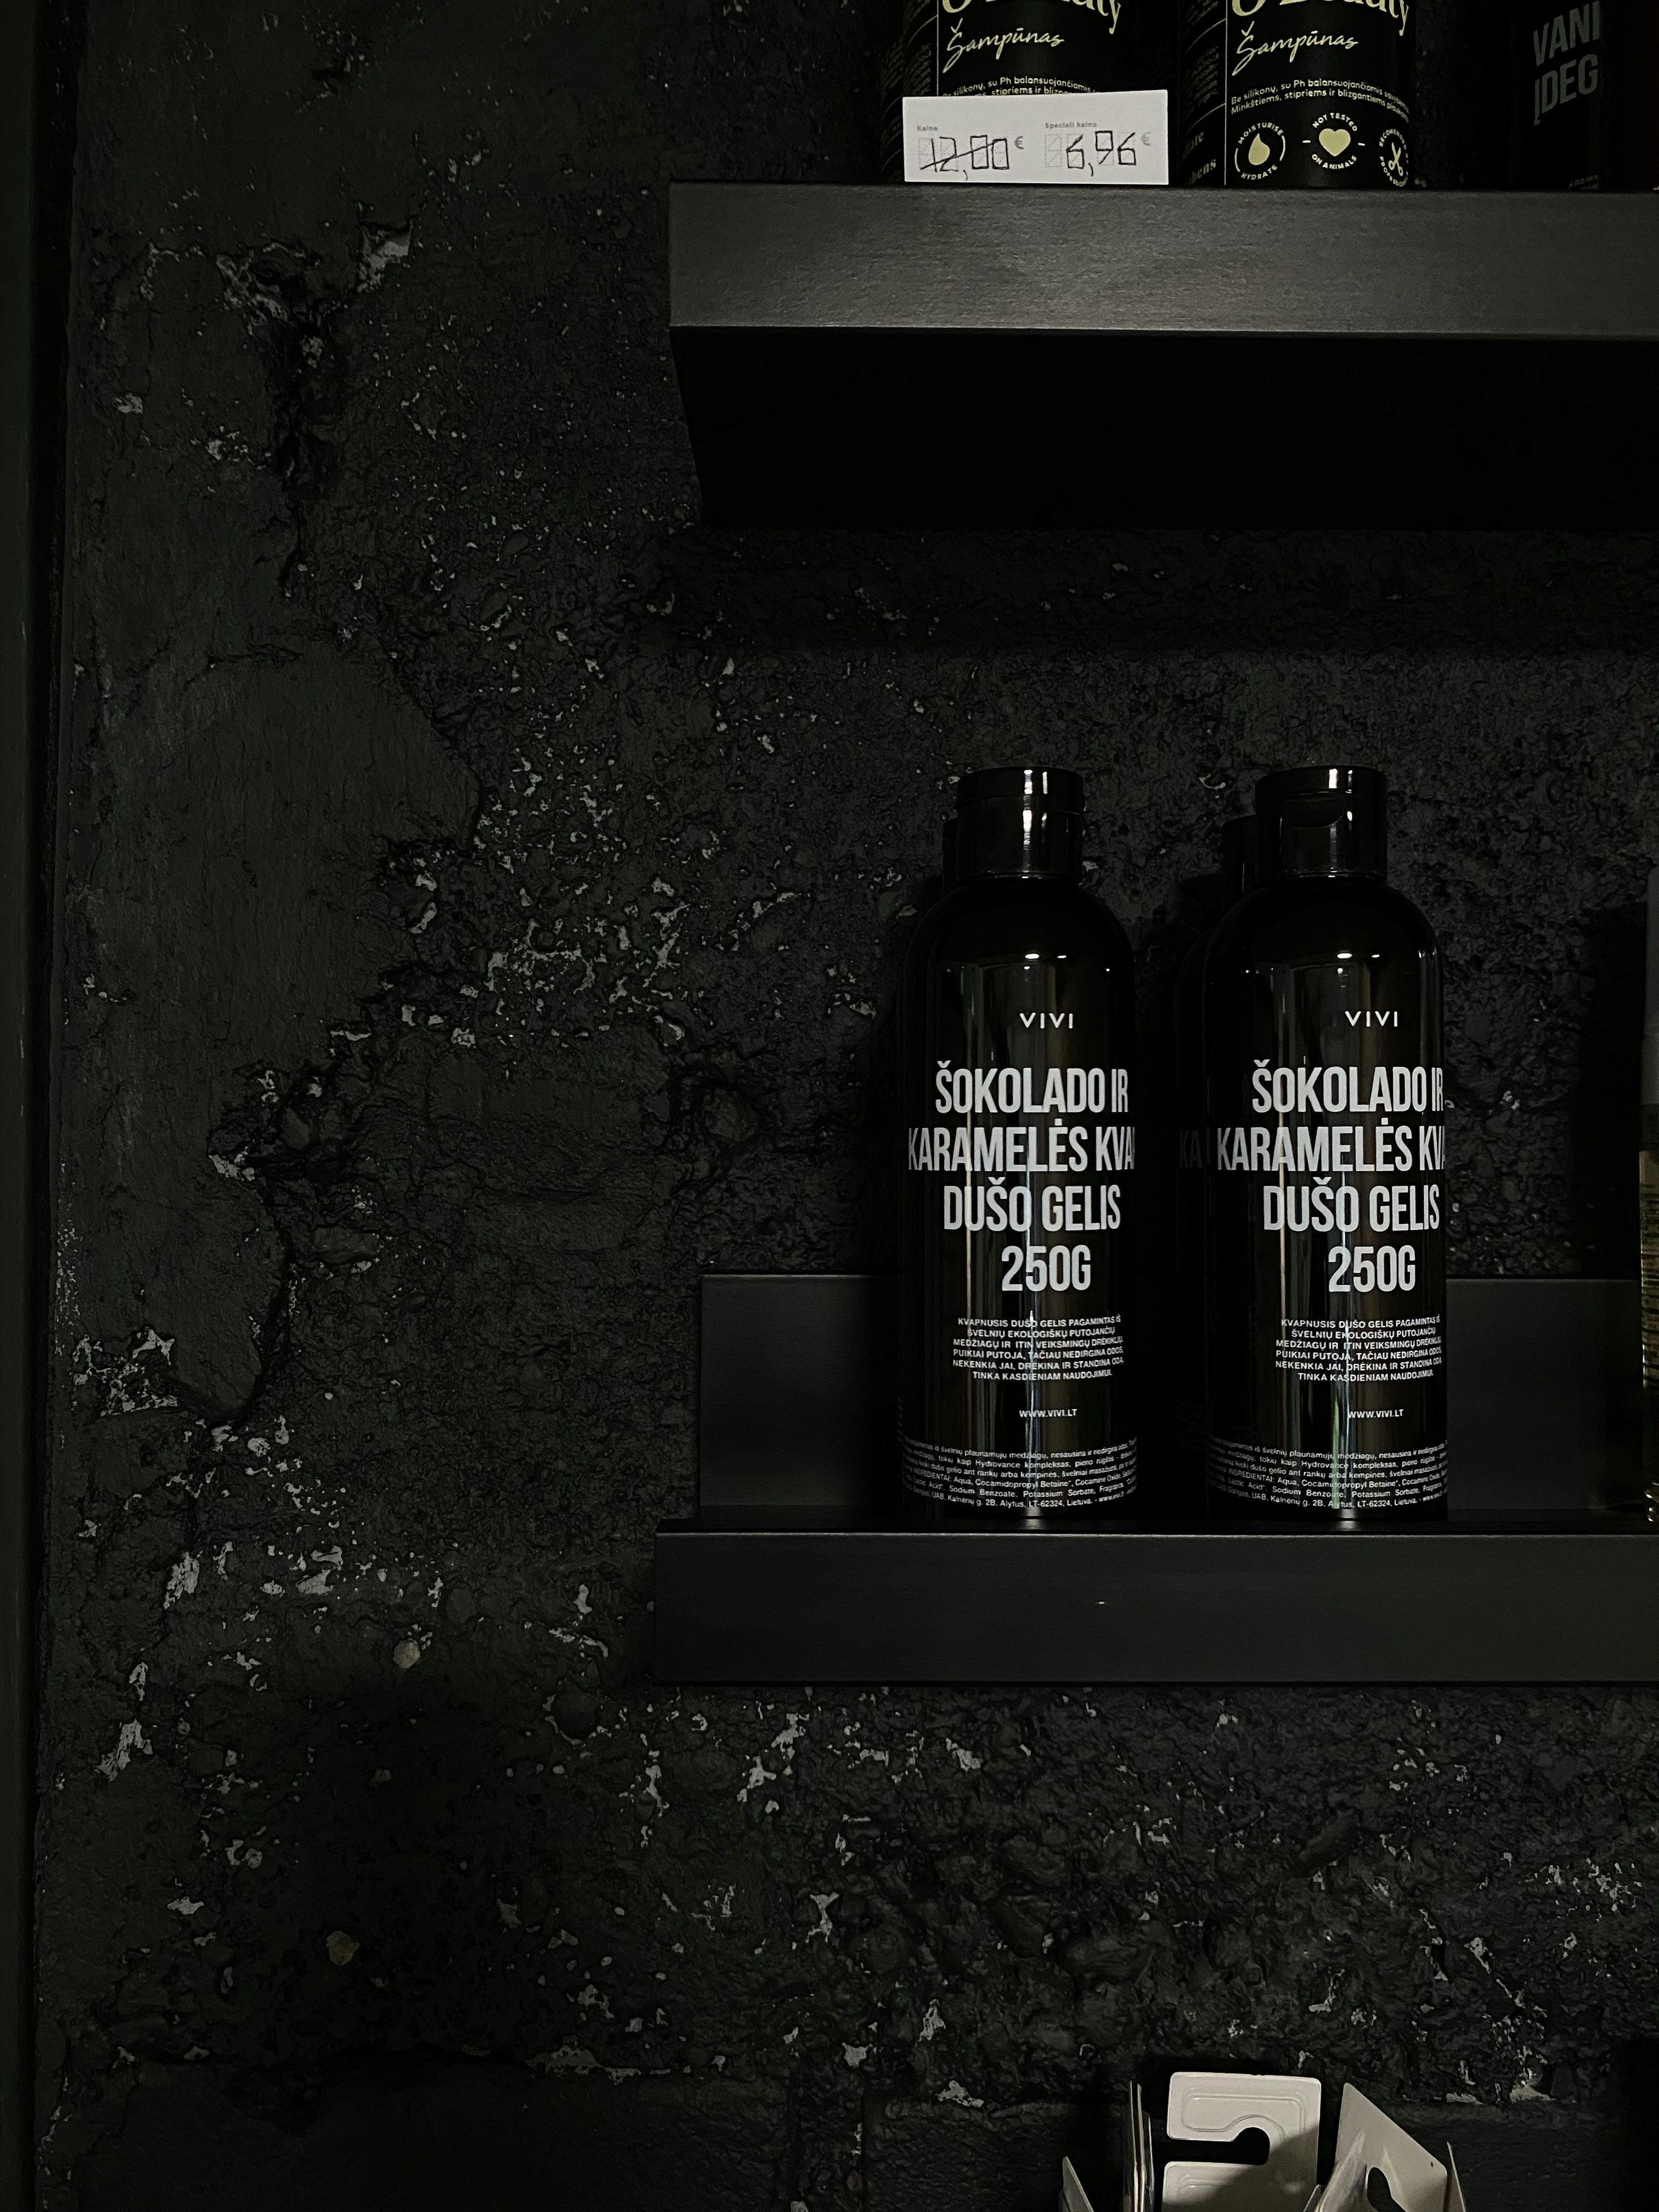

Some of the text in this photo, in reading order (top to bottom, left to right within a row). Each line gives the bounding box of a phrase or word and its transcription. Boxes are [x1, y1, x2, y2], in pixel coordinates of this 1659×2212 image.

[942, 18, 1065, 74] Šampūnas
[1232, 20, 1359, 76] Šampūnas
[1000, 76, 1011, 84] Ph
[1231, 96, 1241, 105] Be
[1284, 89, 1327, 100] stipriems
[1312, 115, 1328, 128] NOT
[1312, 154, 1357, 170] ON ANIMALS
[1241, 165, 1278, 180] HYDRATE
[1019, 1012, 1074, 1029] VIVI
[1344, 1011, 1398, 1028] VIVI
[935, 1060, 1128, 1114] ŠOKOLADO IR
[1252, 1059, 1443, 1114] ŠOKOLADO IR
[908, 1118, 1136, 1172] KARAMELĖS KVA
[1217, 1118, 1412, 1172] KARAMELĖS
[944, 1177, 1121, 1232] DUŠO GELIS
[1263, 1177, 1440, 1232] DUŠO GELIS
[1001, 1245, 1091, 1291] 250G
[1328, 1245, 1416, 1293] 250G
[958, 1318, 1008, 1327] KVAPNUSIS
[1011, 1318, 1037, 1328] DUŠO
[1040, 1319, 1066, 1328] GELIS
[1069, 1316, 1115, 1327] PAGAMINTAS
[1281, 1319, 1336, 1328] KVAPNUSIS
[1339, 1319, 1365, 1328] DUŠO
[1368, 1320, 1393, 1328] GELIS
[1395, 1317, 1436, 1327] PAGAMINTAS
[967, 1328, 1005, 1338] ŠVELNIŲ
[1008, 1329, 1068, 1339] EKOLOGIŠKŲ
[1291, 1329, 1333, 1339] ŠVELNIŲ
[1335, 1330, 1395, 1340] EKOLOGIŠKŲ
[953, 1338, 999, 1350] MEDŽIAGŲ
[1035, 1339, 1090, 1349] VEIKSMINGŲ
[1276, 1338, 1326, 1351] MEDŽIAGŲ
[1364, 1340, 1414, 1350] VEIKSMINGŲ
[953, 1349, 984, 1358] PUIKIAI
[1028, 1349, 1061, 1359] TAČIAU
[1063, 1349, 1105, 1358] NEDIRGINA
[1276, 1350, 1310, 1358] PUIKIAI
[1356, 1351, 1388, 1360] TAČIAU
[1390, 1350, 1427, 1359] NEDIRGINA
[952, 1359, 997, 1369] NEKENKIA
[1073, 1359, 1110, 1369] STANDINA
[1276, 1361, 1323, 1370] NEKENKIA
[1400, 1359, 1432, 1369] STANDINA
[973, 1372, 1000, 1380] TINKA
[1298, 1372, 1388, 1381] TINKA KASDIENIAM
[1019, 1408, 1078, 1418] WWW.VIVI.LT
[1348, 1409, 1404, 1419] WWW.VIVI.LT
[975, 1459, 1020, 1469] Hydrovance
[1301, 1460, 1348, 1469] Hydrovance
[975, 1479, 1037, 1488] Cocamidopropyl
[1301, 1479, 1367, 1489] Cocamidopropyl
[949, 1485, 975, 1494] Sodium
[979, 1488, 1018, 1498] Benzoate,
[1023, 1490, 1063, 1498] Potassium
[1272, 1486, 1301, 1496] Sodium
[1352, 1490, 1391, 1498] Potassium
